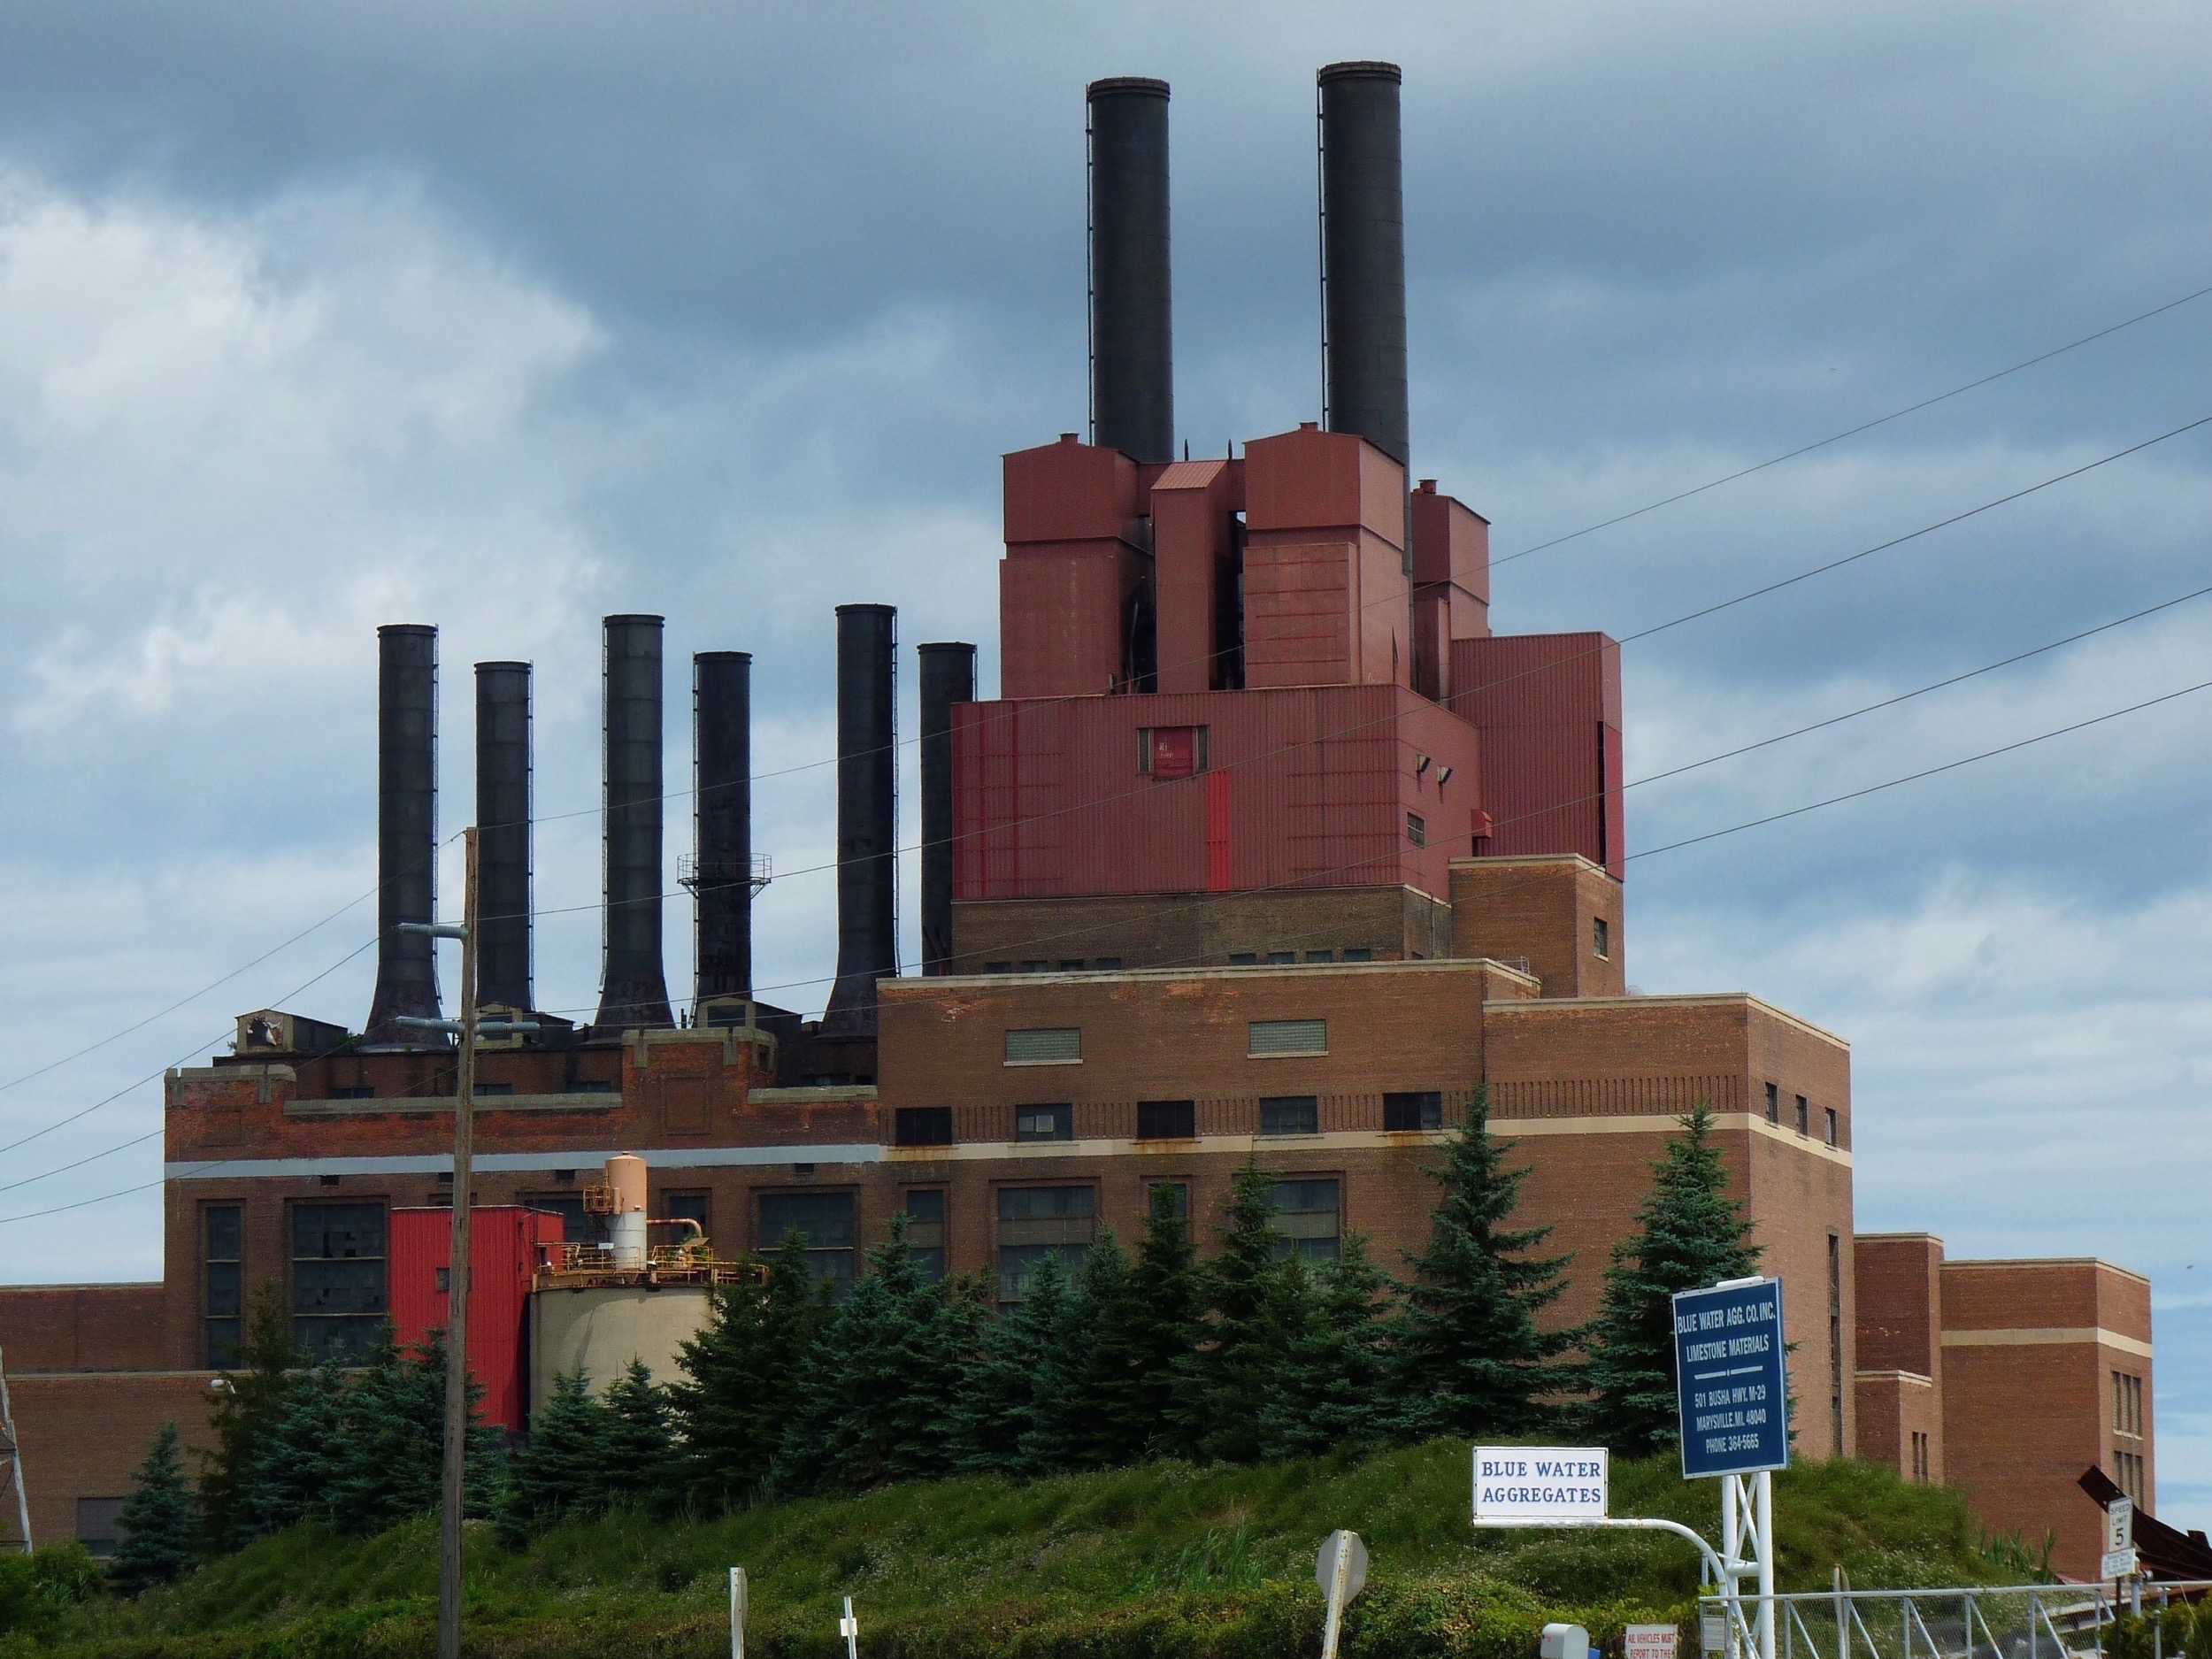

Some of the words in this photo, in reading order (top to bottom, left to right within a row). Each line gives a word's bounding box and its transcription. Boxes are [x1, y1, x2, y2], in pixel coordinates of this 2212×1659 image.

[1678, 1314, 1697, 1333] BLUE
[1699, 1310, 1724, 1330] WATER
[1726, 1307, 1745, 1326] AGG.
[1746, 1304, 1758, 1323] CO.
[1759, 1302, 1776, 1321] INC.
[1686, 1340, 1727, 1362] LIMESTONE
[1729, 1334, 1769, 1356] MATERIALS
[1694, 1393, 1706, 1408] 501
[1709, 1389, 1731, 1407] BUSHA
[1732, 1386, 1747, 1403] HWY.
[1748, 1384, 1766, 1402] M-29
[1746, 1409, 1766, 1425] 48040
[1706, 1437, 1727, 1454] PHONE
[1482, 1461, 1527, 1477] BLUE
[1535, 1462, 1601, 1477] WATER
[1482, 1486, 1601, 1502] AGGREGATES
[2109, 1504, 2130, 1515] SPEED
[2115, 1527, 2124, 1546] 5
[1637, 1634, 1660, 1643] VEHICLES
[1661, 1633, 1674, 1643] MUST
